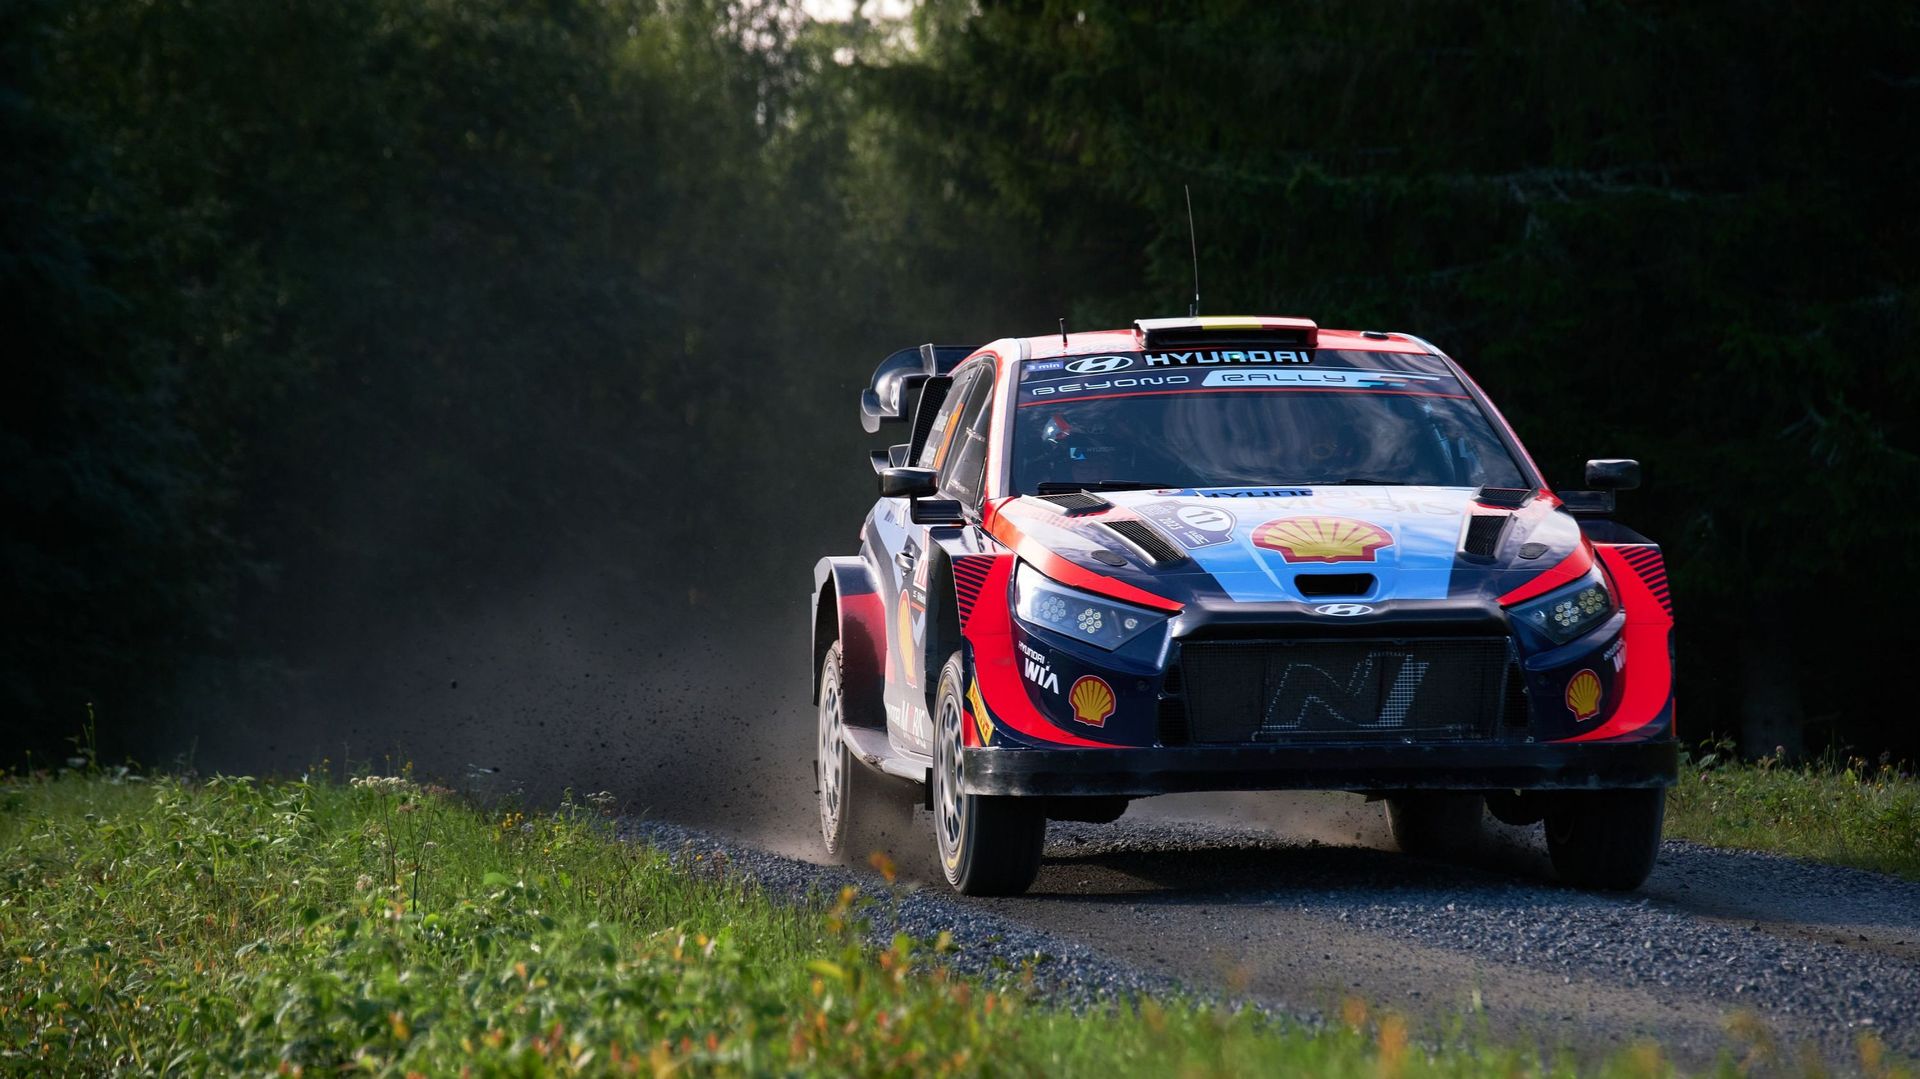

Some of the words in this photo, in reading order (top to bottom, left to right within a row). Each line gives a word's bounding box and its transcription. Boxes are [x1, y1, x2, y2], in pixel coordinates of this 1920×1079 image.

[1145, 351, 1310, 366] HYUNDAI
[1032, 375, 1190, 396] BEYOND
[1221, 373, 1346, 383] RALLY
[1185, 510, 1224, 525] 11
[1018, 640, 1046, 665] HYUNDAI
[1024, 657, 1060, 695] WIA
